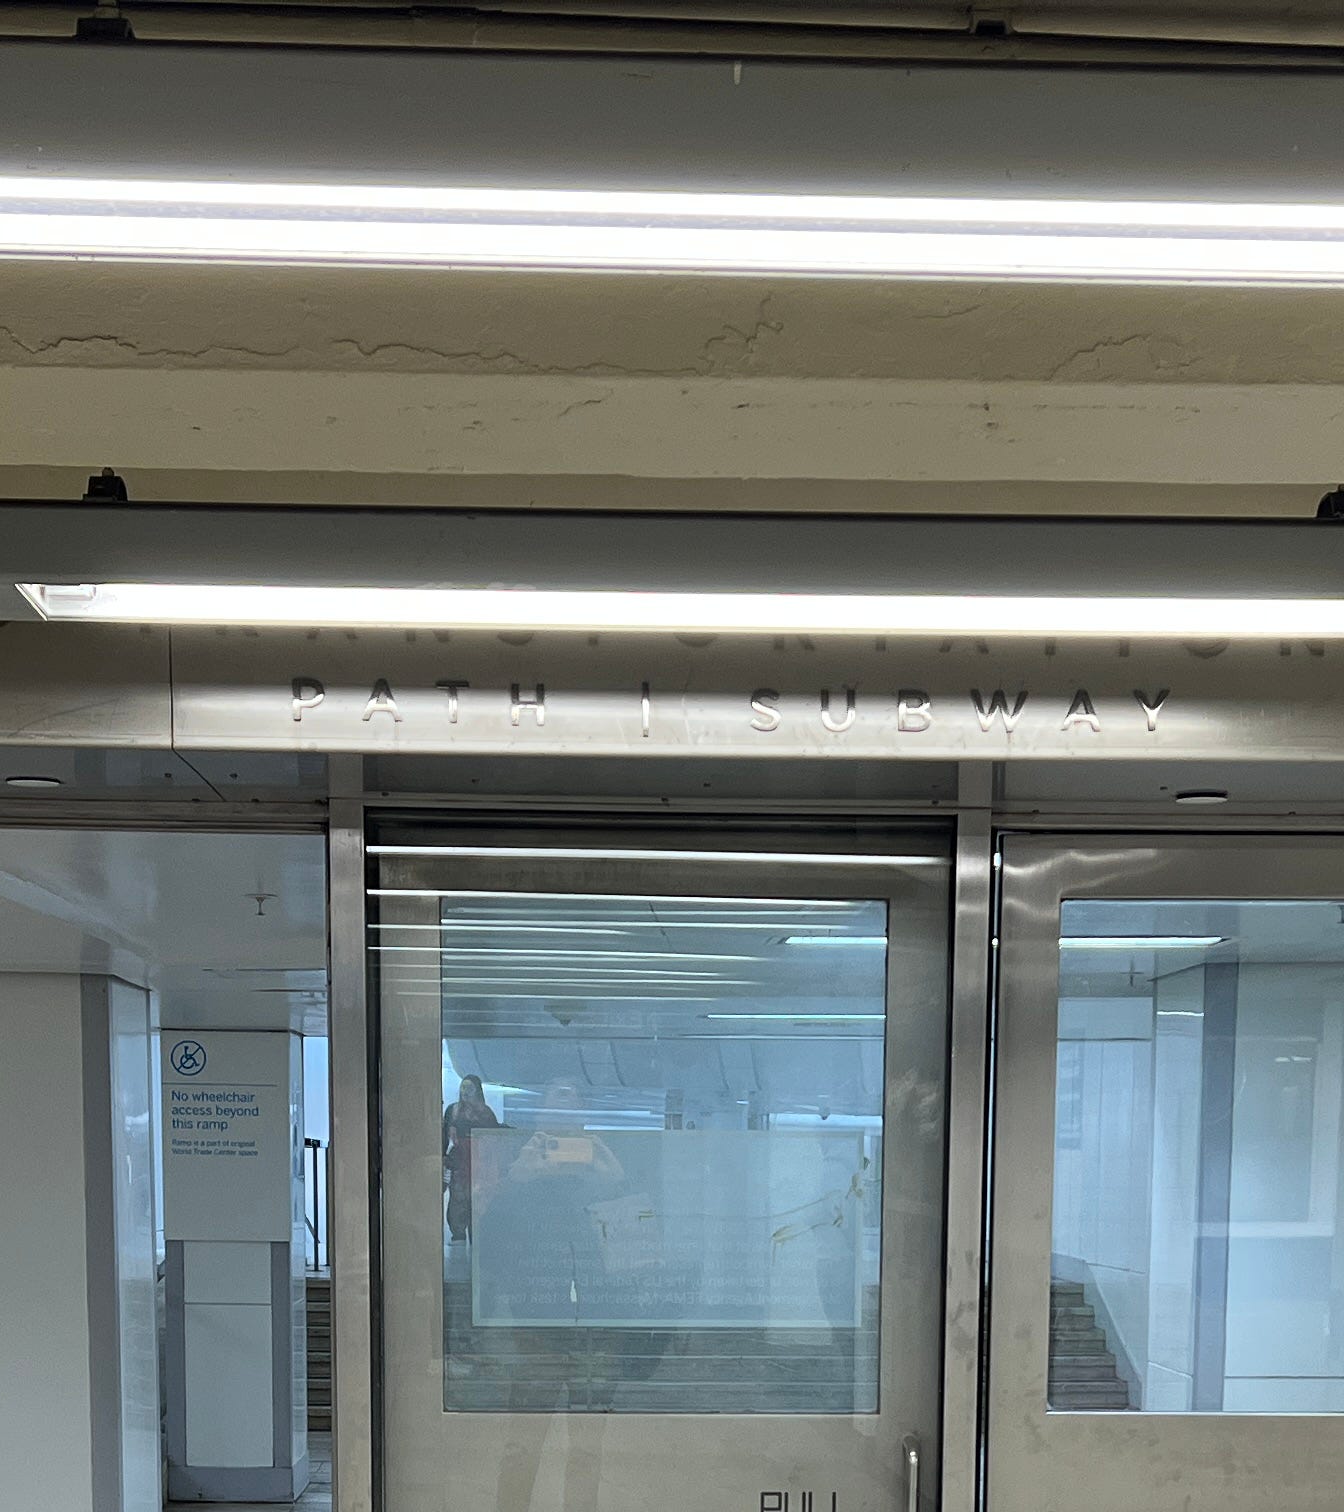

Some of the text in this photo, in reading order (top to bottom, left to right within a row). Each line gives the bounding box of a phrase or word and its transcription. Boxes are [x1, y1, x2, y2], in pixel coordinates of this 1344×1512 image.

[291, 676, 545, 727] PATH
[749, 687, 1172, 734] SUBWAY
[171, 1089, 256, 1103] No wheelchair
[171, 1104, 259, 1118] access beyond
[172, 1117, 229, 1132] this ramp
